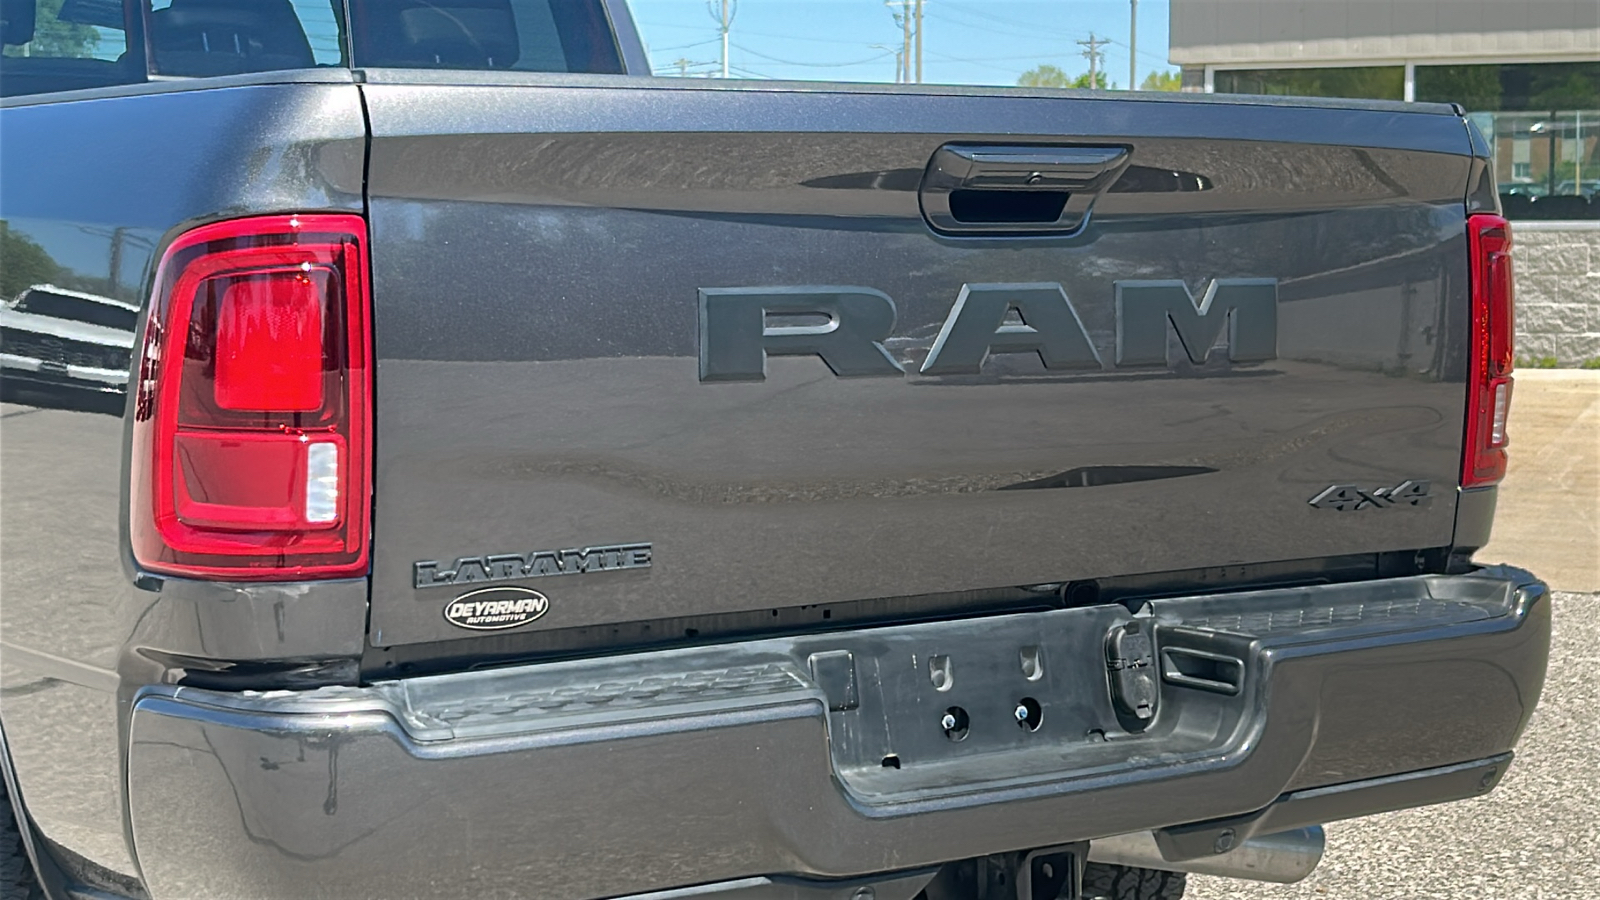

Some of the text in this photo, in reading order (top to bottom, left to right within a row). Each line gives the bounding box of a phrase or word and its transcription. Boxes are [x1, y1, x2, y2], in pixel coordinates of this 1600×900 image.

[698, 278, 1278, 382] RAM
[413, 542, 652, 588] LARAMIE
[449, 598, 545, 618] DEYARMAN
[466, 613, 527, 625] AUTOMOTIVE
